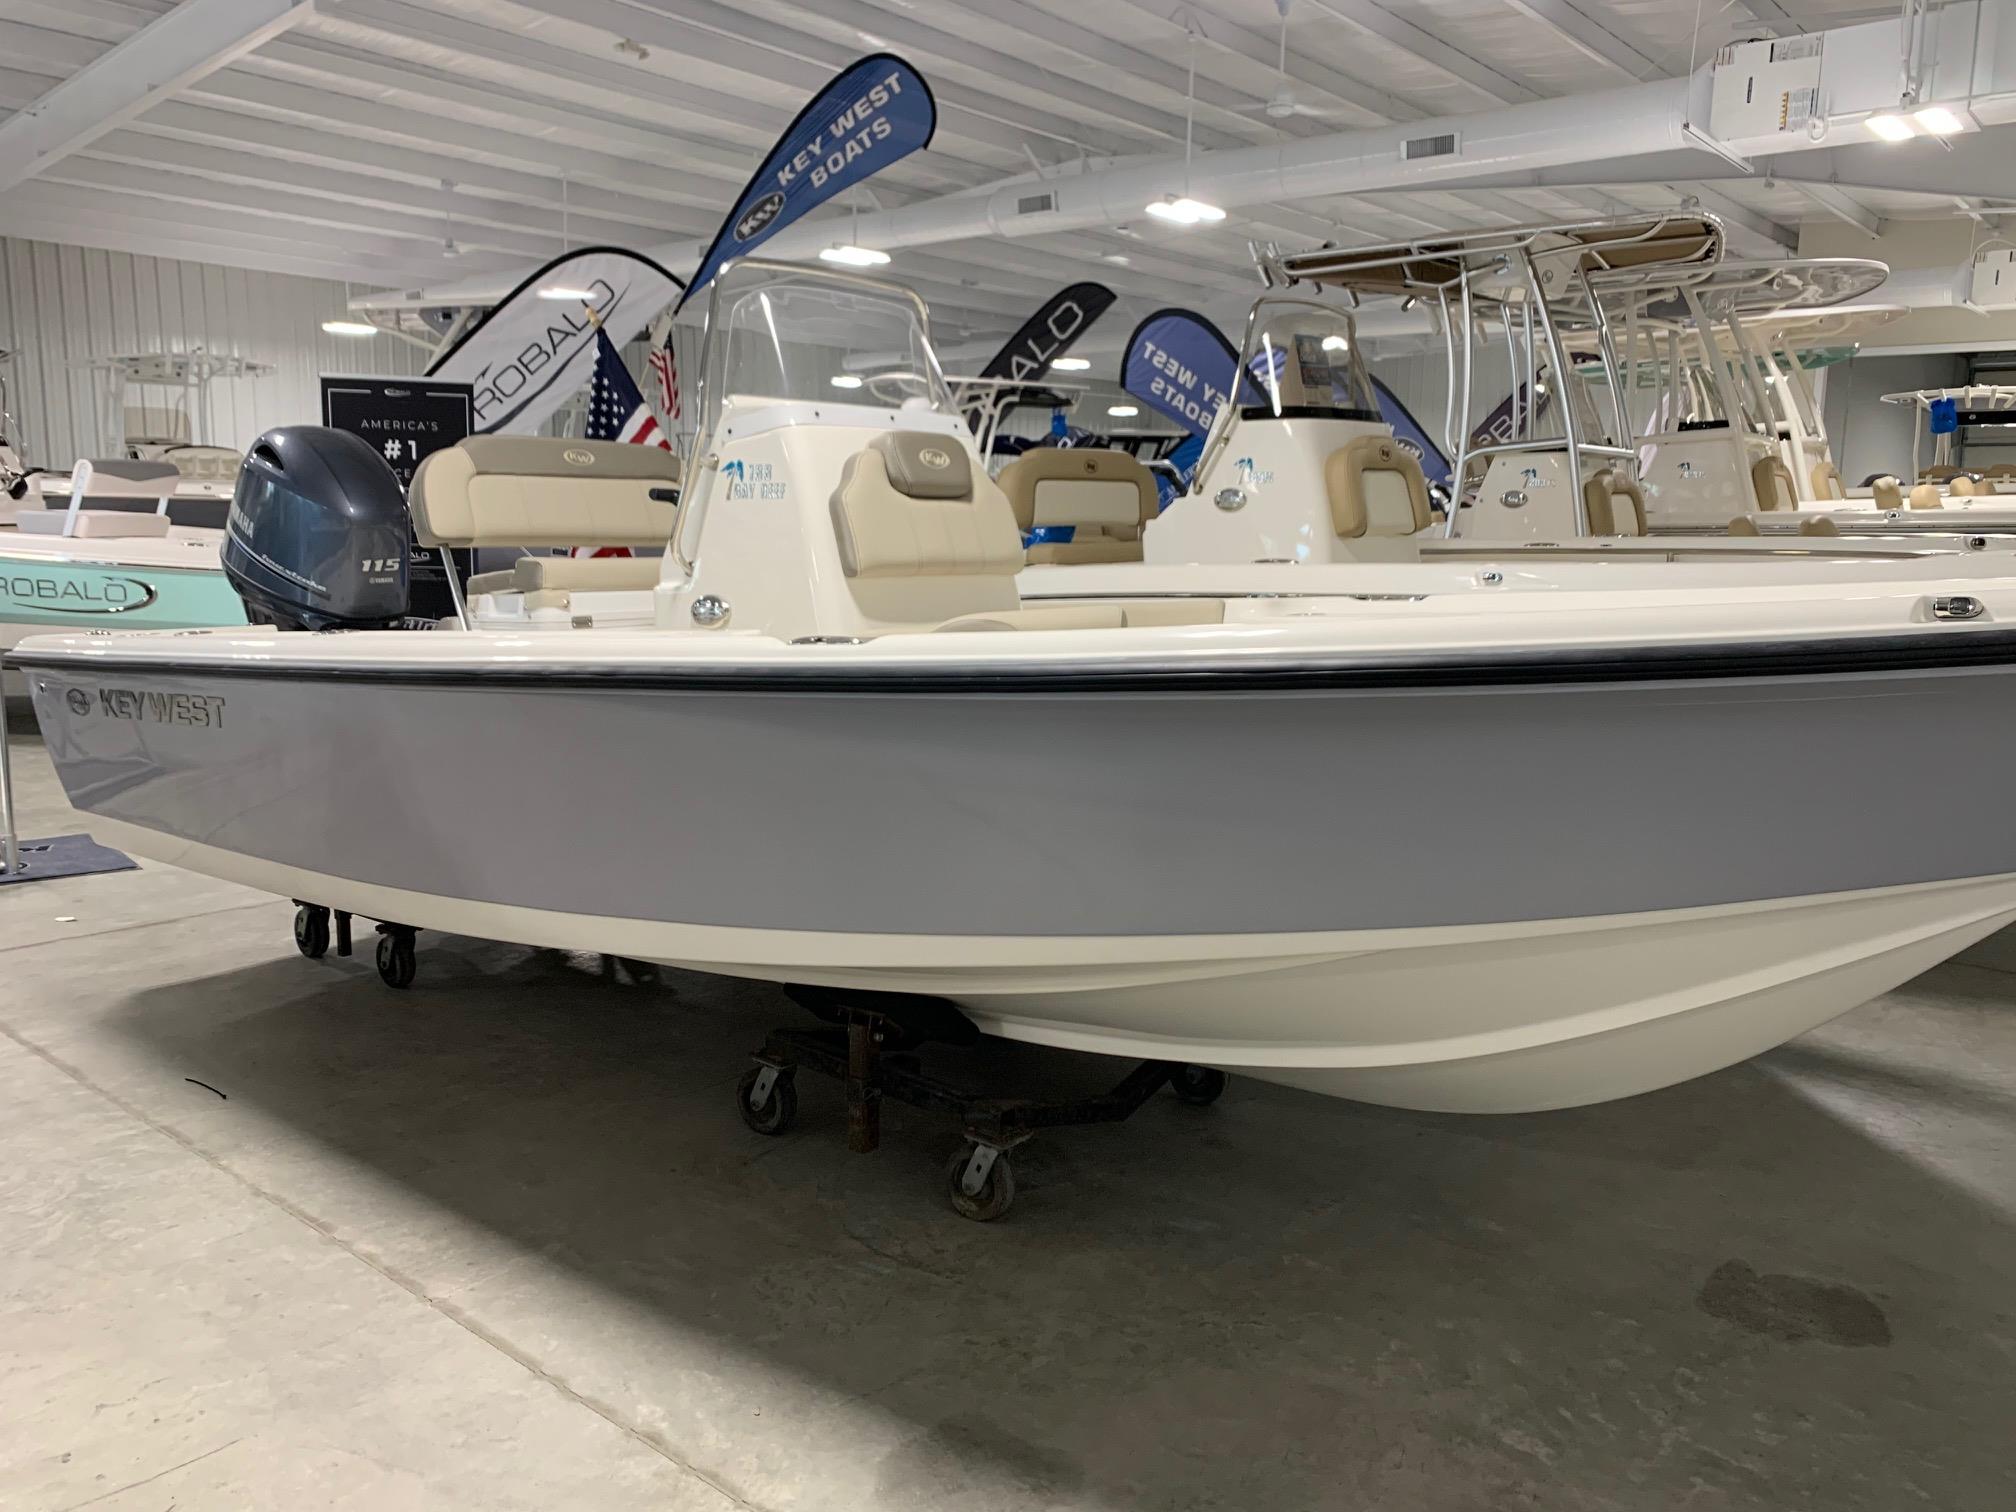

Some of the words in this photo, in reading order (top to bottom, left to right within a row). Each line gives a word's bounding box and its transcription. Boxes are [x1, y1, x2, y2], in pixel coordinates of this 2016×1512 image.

[777, 135, 823, 187] KEY
[829, 71, 902, 138] WEST
[809, 116, 893, 189] BOATS
[737, 196, 781, 237] KW
[1011, 301, 1084, 383] ALO
[361, 418, 439, 432] AMERICA'S
[361, 558, 401, 573] 115
